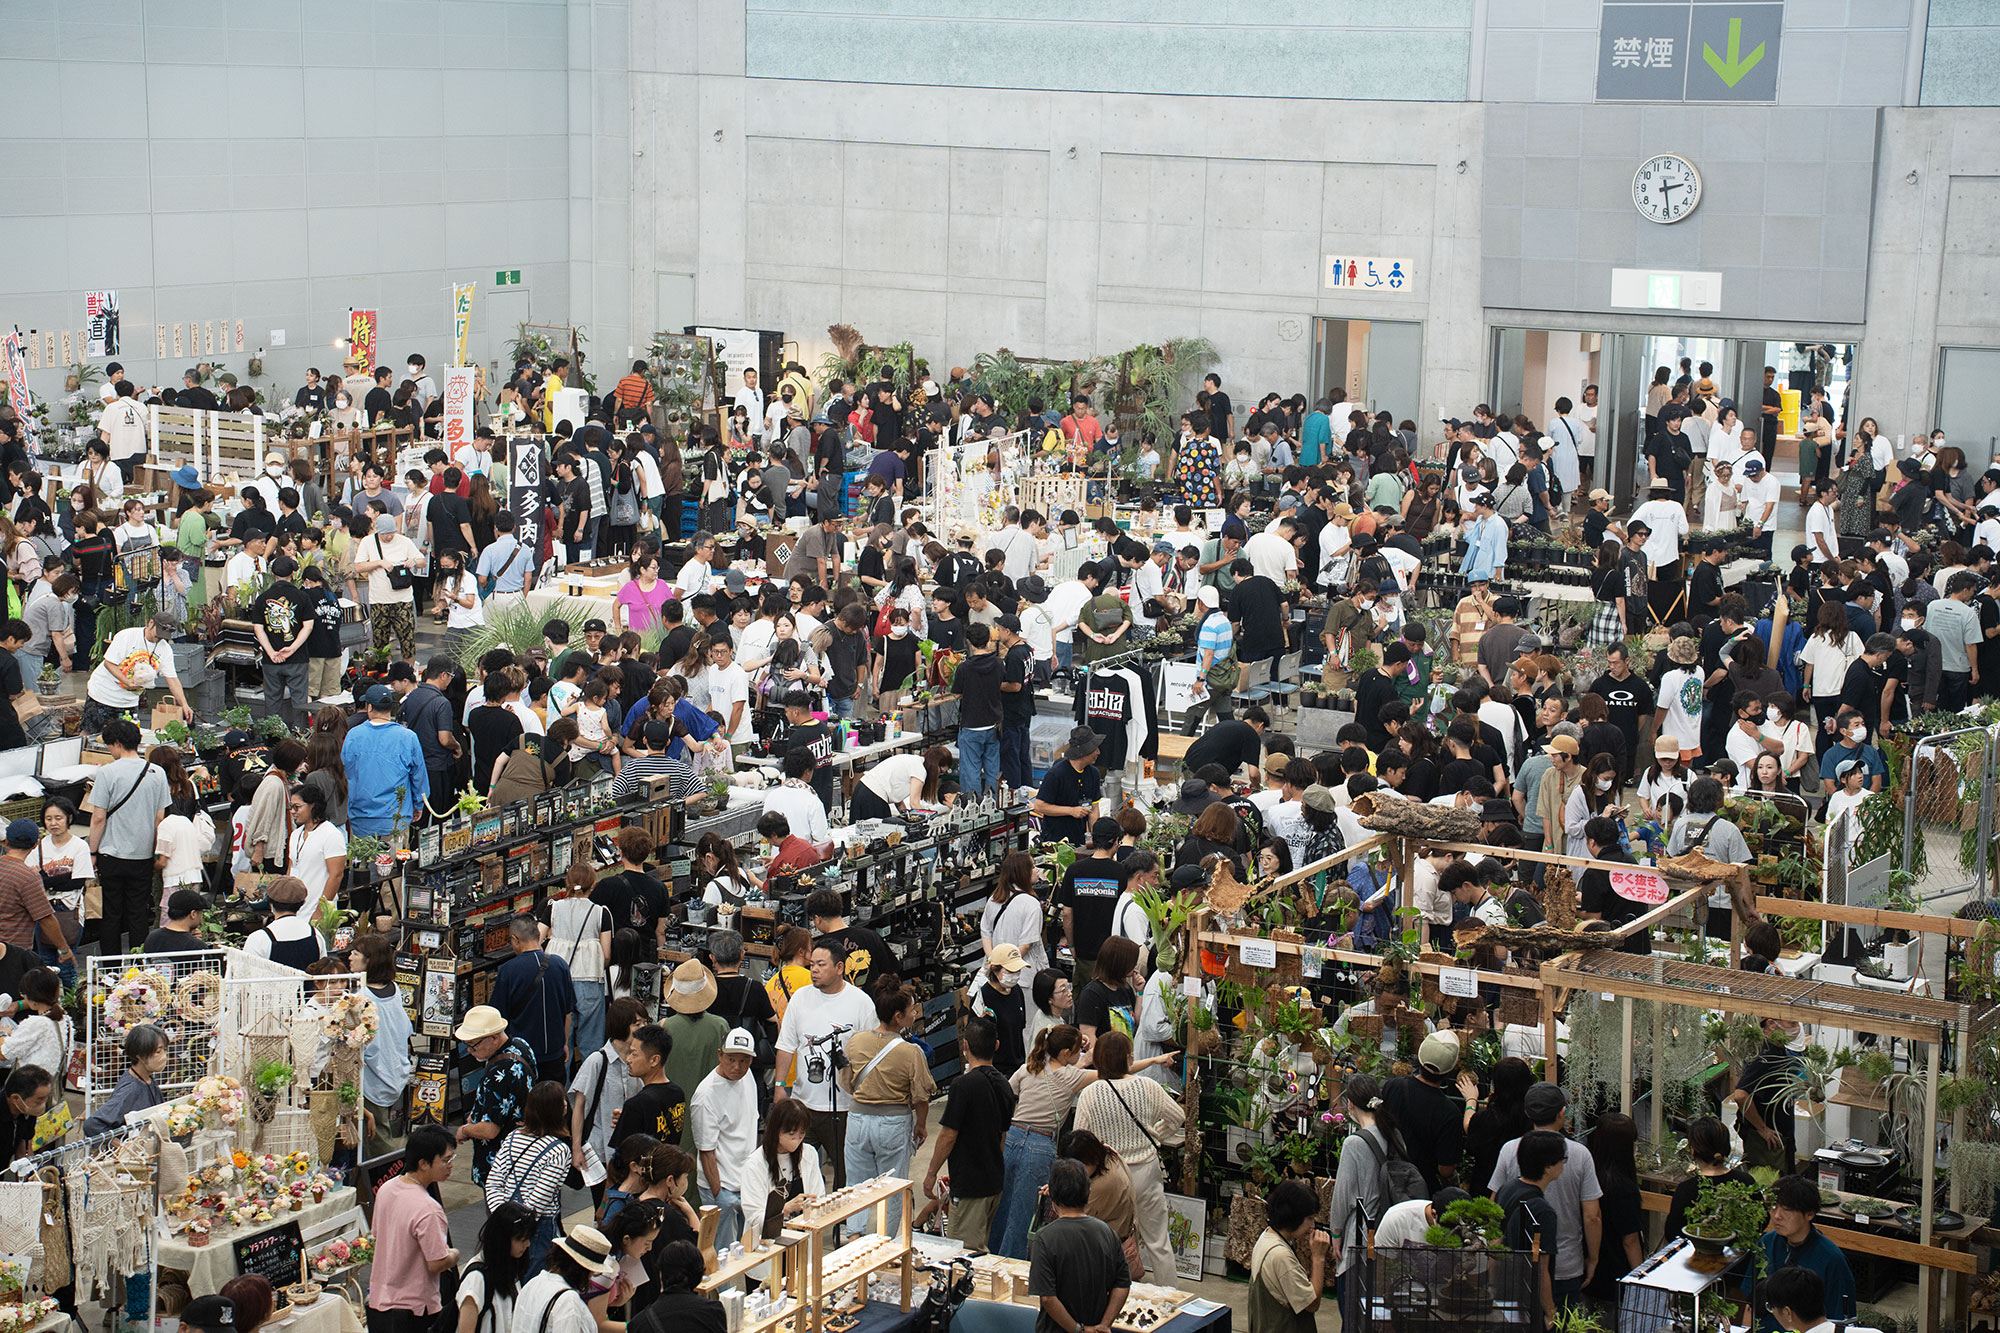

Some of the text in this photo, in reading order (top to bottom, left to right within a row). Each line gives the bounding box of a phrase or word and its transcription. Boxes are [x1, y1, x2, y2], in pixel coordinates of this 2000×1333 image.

[1611, 37, 1674, 69] 禁煙
[1653, 162, 1660, 172] 11
[1664, 160, 1671, 170] 12
[1677, 163, 1681, 173] 1
[1643, 171, 1652, 181] 10
[1684, 172, 1690, 181] 2
[1641, 184, 1647, 193] 9
[1687, 185, 1693, 194] 3
[1643, 196, 1650, 205] 8
[1682, 197, 1688, 206] 4
[1652, 205, 1658, 214] 7
[1662, 208, 1668, 217] 6
[1673, 205, 1679, 214] 5
[87, 292, 106, 342] 獣道
[510, 489, 540, 552] 多肉
[1612, 872, 1658, 888] あく抜き
[1077, 887, 1116, 897] patagonia
[1624, 886, 1667, 902] ベラボン
[397, 973, 420, 984] ISTORIC
[421, 1088, 437, 1102] 66
